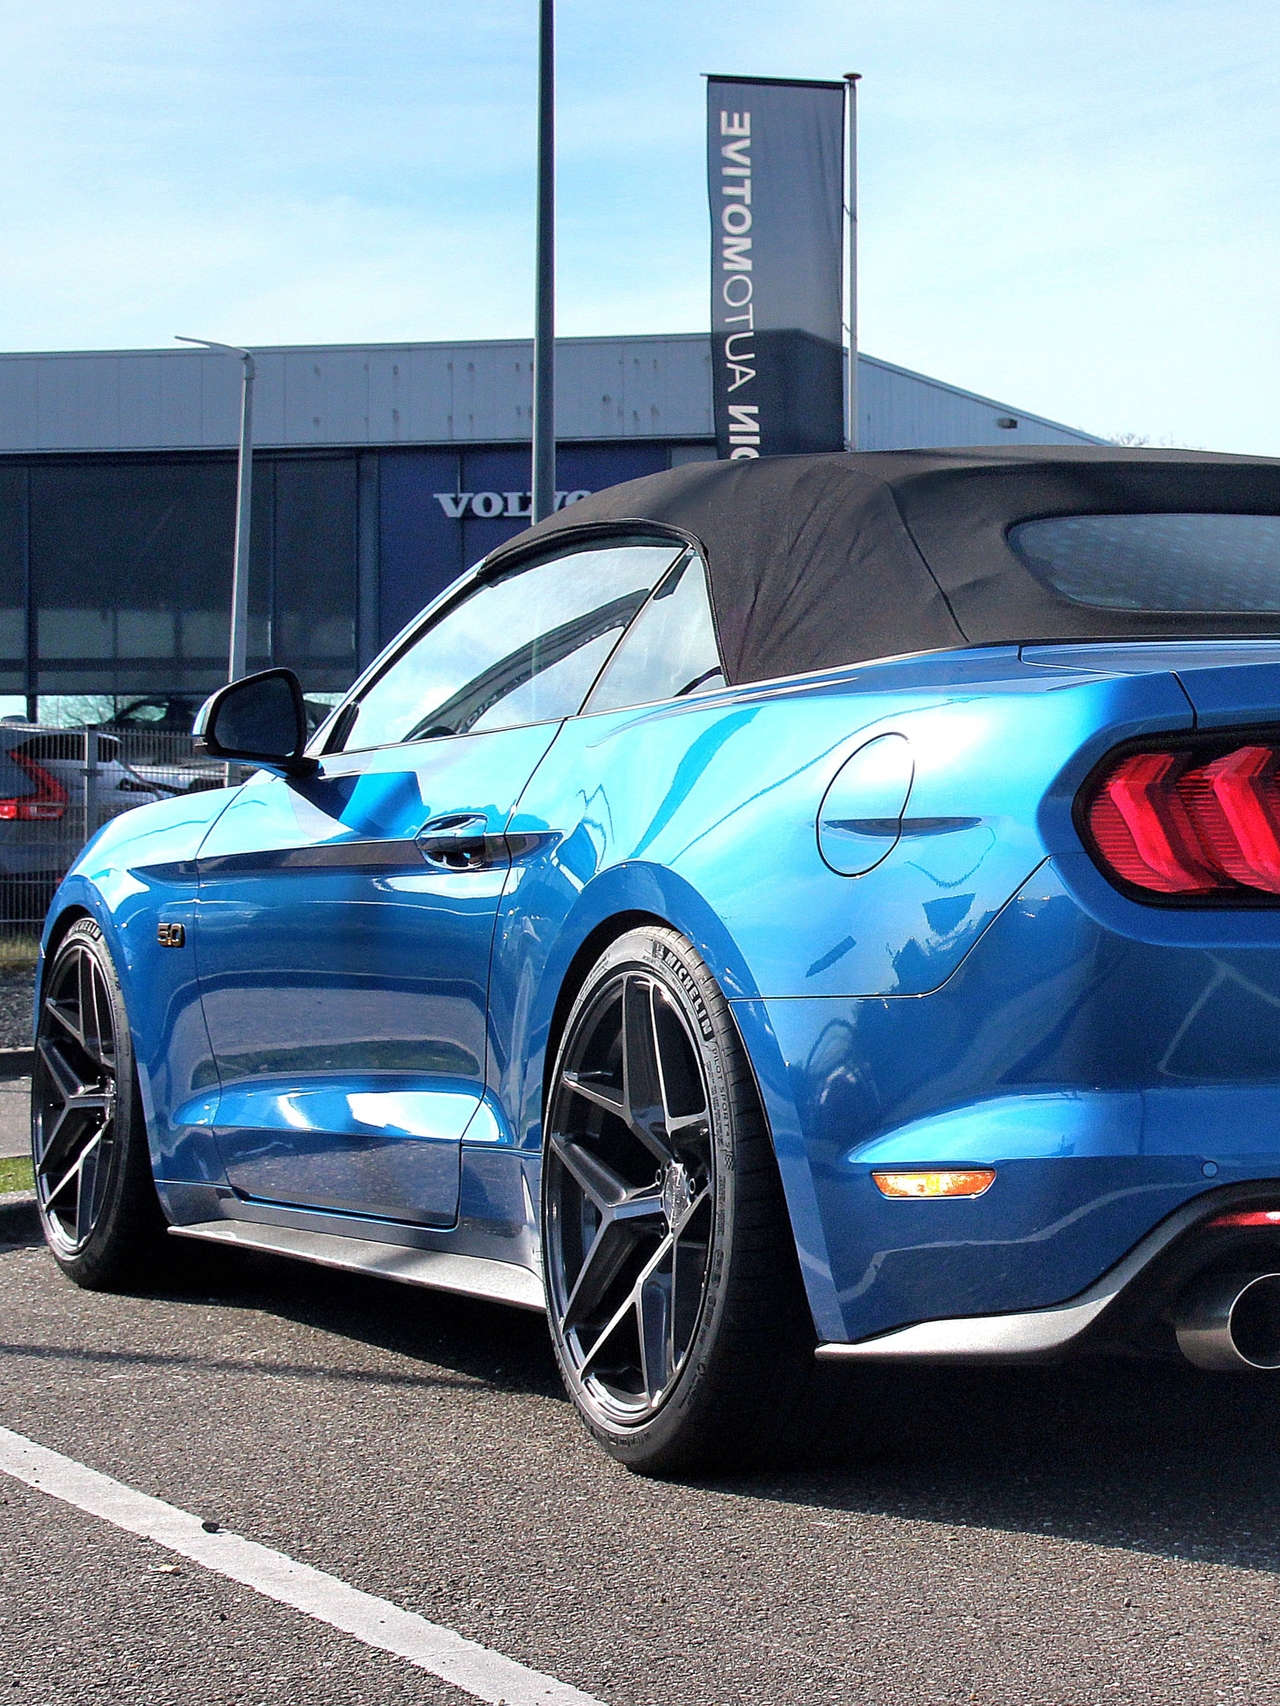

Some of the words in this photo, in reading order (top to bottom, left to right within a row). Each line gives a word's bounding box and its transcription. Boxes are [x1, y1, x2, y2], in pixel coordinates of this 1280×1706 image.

[664, 950, 713, 1036] MICHELIN
[711, 1048, 723, 1080] PILOT
[720, 1086, 730, 1127] SPORT
